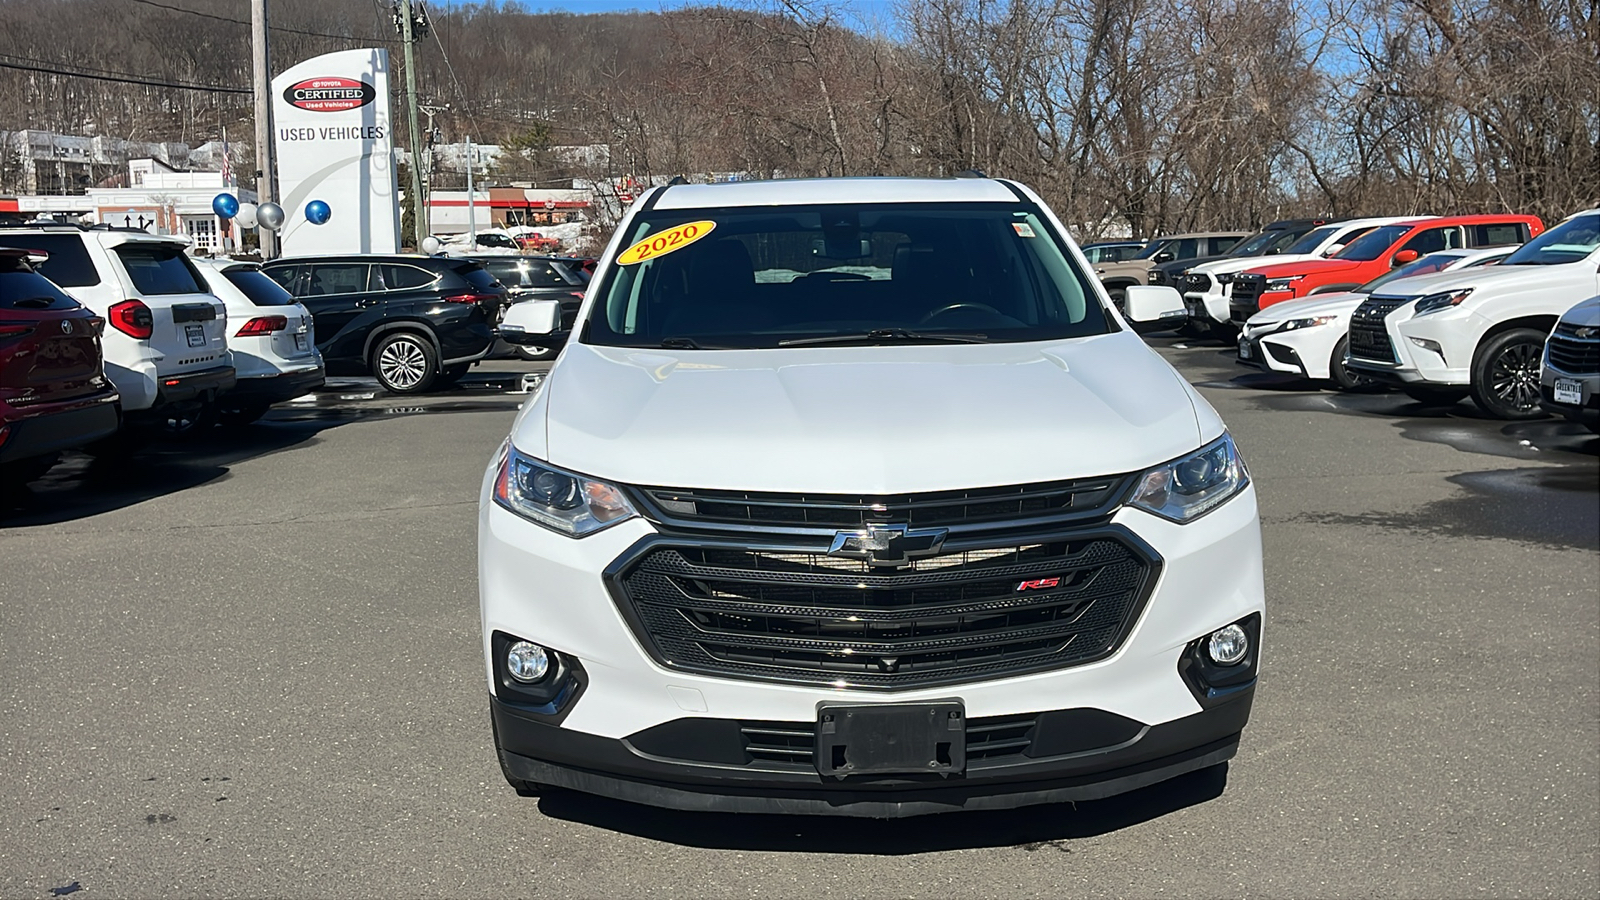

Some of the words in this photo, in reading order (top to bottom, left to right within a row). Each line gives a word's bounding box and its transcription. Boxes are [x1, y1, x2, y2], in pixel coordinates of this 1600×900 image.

[294, 89, 364, 100] CERTIFIED
[280, 127, 315, 141] USED
[319, 126, 384, 140] VEHICLES
[636, 225, 698, 259] 2020
[1016, 577, 1060, 591] RS
